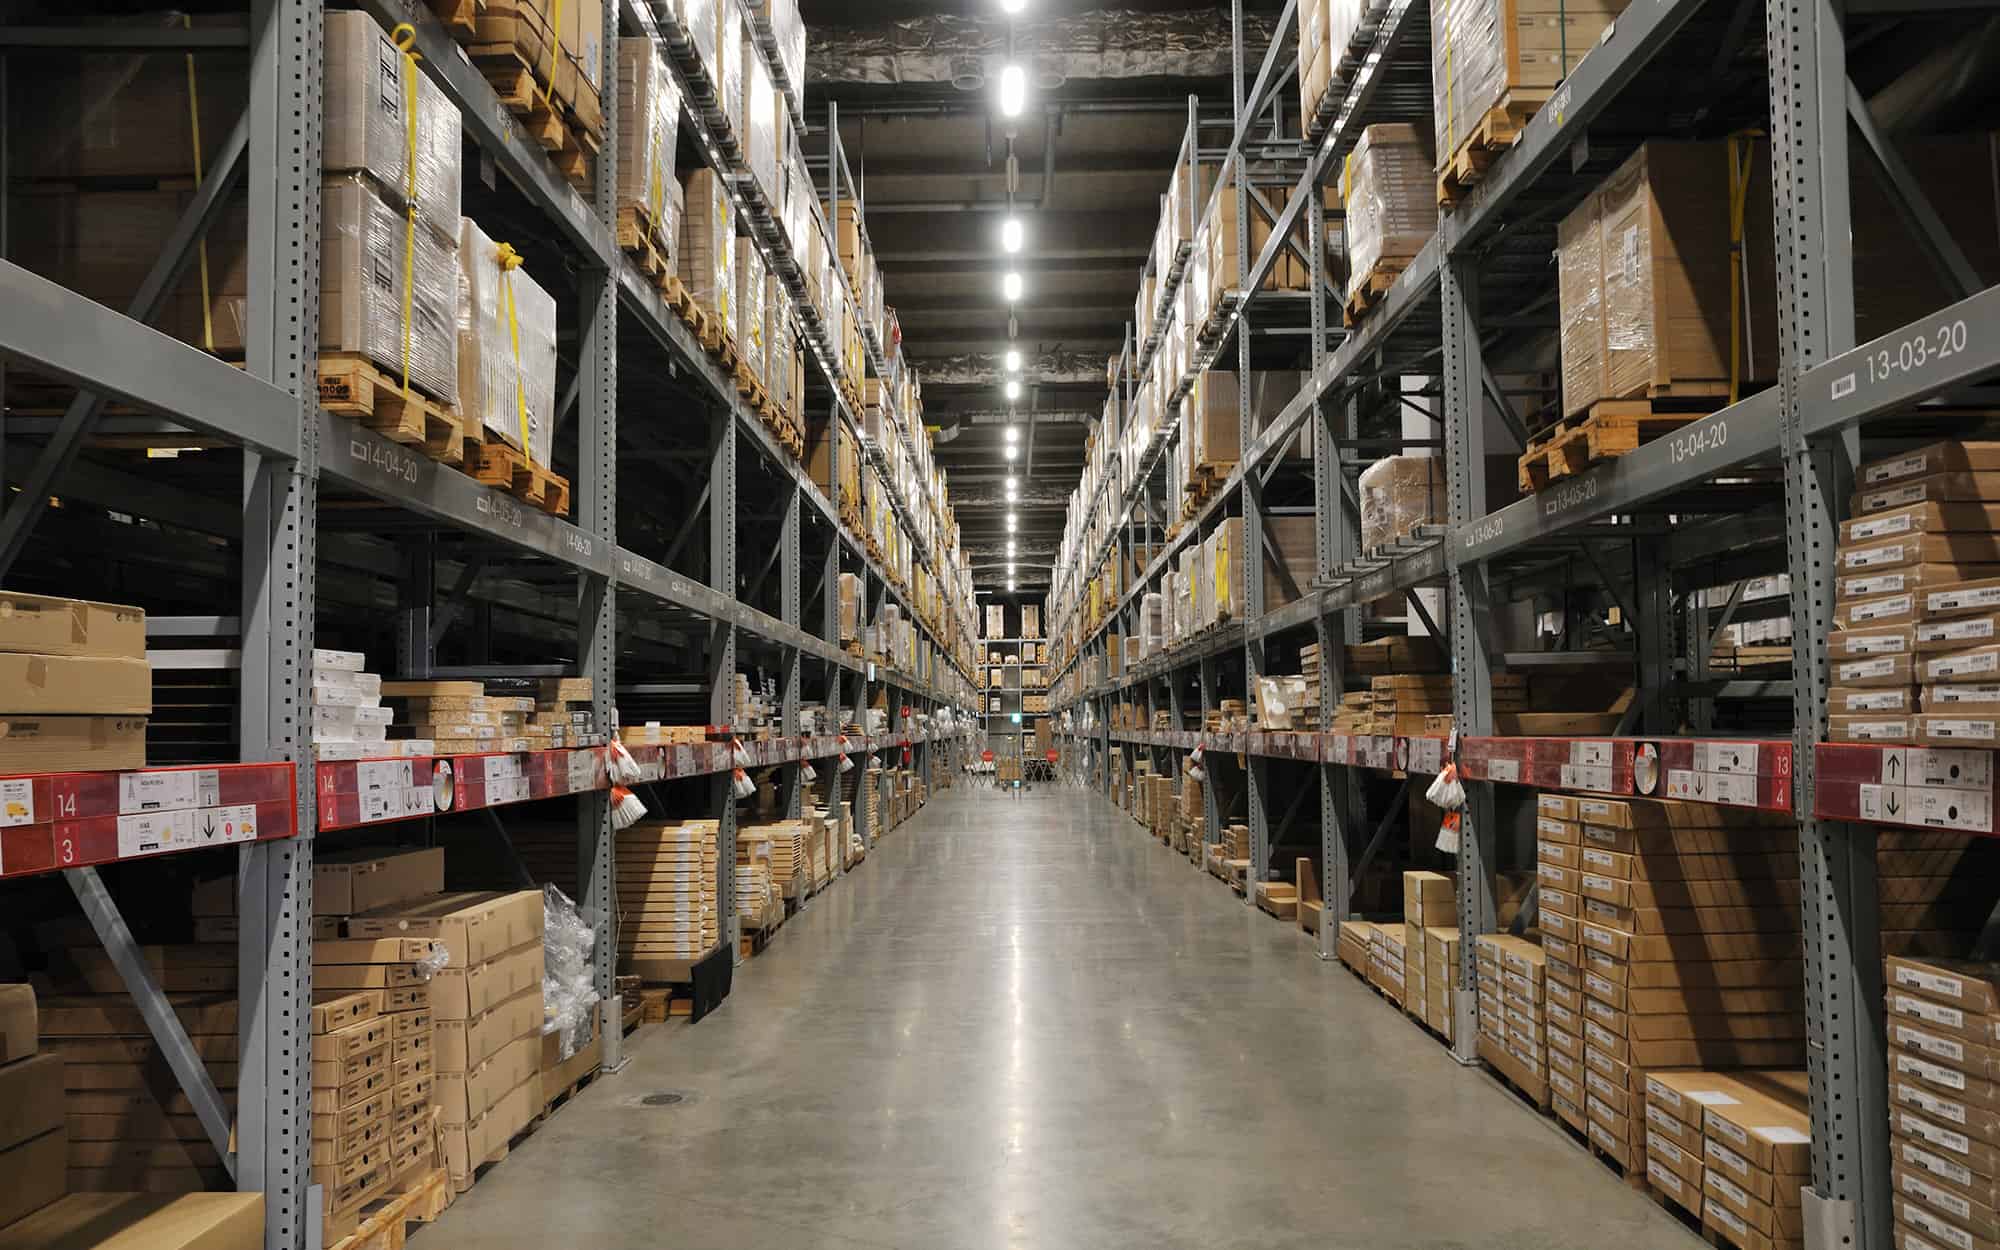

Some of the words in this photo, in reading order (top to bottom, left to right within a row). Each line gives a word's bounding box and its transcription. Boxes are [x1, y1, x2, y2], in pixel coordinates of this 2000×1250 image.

[1866, 319, 1967, 385] 13-03-20
[1669, 421, 1728, 465] 13-04-20
[367, 440, 418, 484] 14-04-20
[1557, 477, 1598, 513] 13-05-20
[1776, 755, 1789, 775] 13
[323, 775, 335, 793] 14
[1775, 786, 1785, 807] 4
[57, 791, 77, 818] 14
[326, 806, 334, 825] 4
[61, 838, 74, 863] 3
